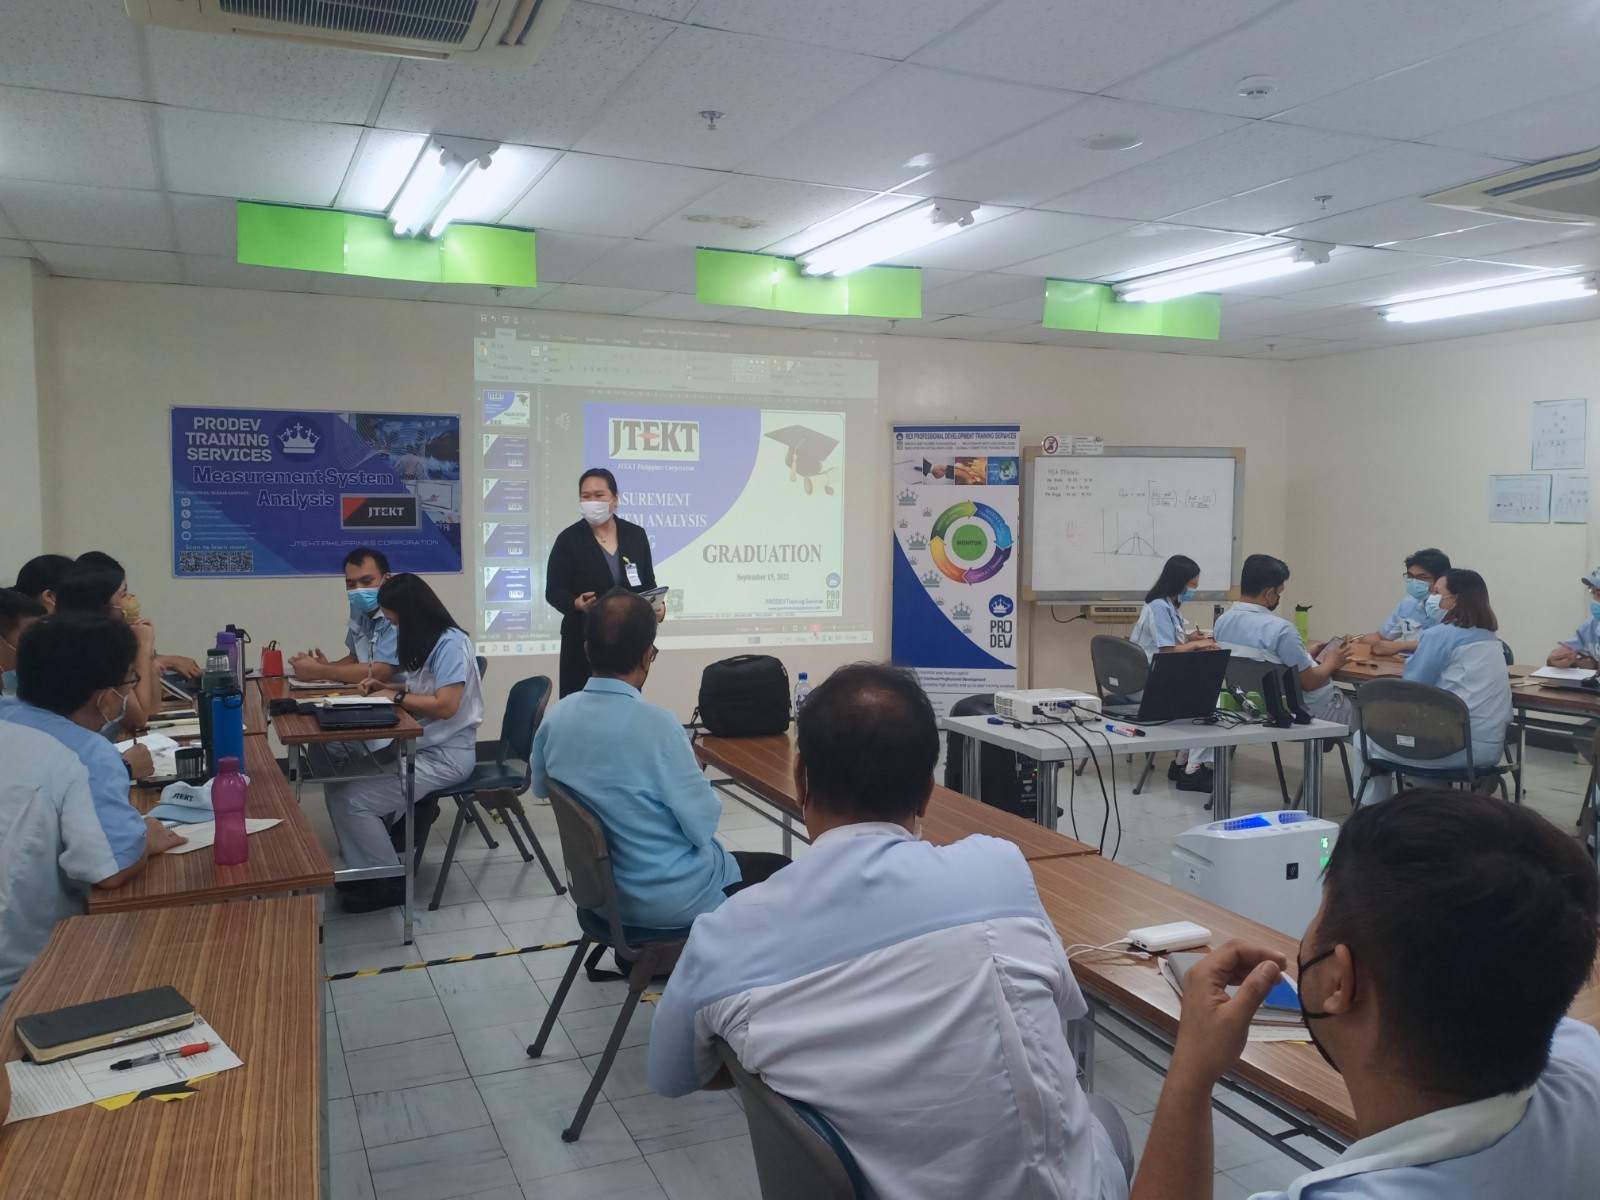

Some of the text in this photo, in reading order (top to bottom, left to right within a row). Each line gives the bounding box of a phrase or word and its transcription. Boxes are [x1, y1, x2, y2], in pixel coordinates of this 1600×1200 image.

[193, 416, 261, 431] PRODEV
[185, 432, 269, 447] TRAINING
[609, 419, 699, 457] JTEKT
[186, 448, 273, 463] SERVICES
[192, 465, 394, 489] Measurement System
[256, 489, 335, 511] Analysis
[617, 492, 692, 506] ASUREMENT
[368, 506, 405, 518] JTEKT
[646, 514, 707, 528] ANALYSIS
[702, 544, 822, 563] GRADUATION
[736, 573, 766, 583] September
[826, 590, 840, 599] PRO
[826, 600, 840, 609] DEV
[990, 620, 1013, 633] PRO
[990, 634, 1013, 648] DEV
[172, 792, 194, 802] JTEKT
